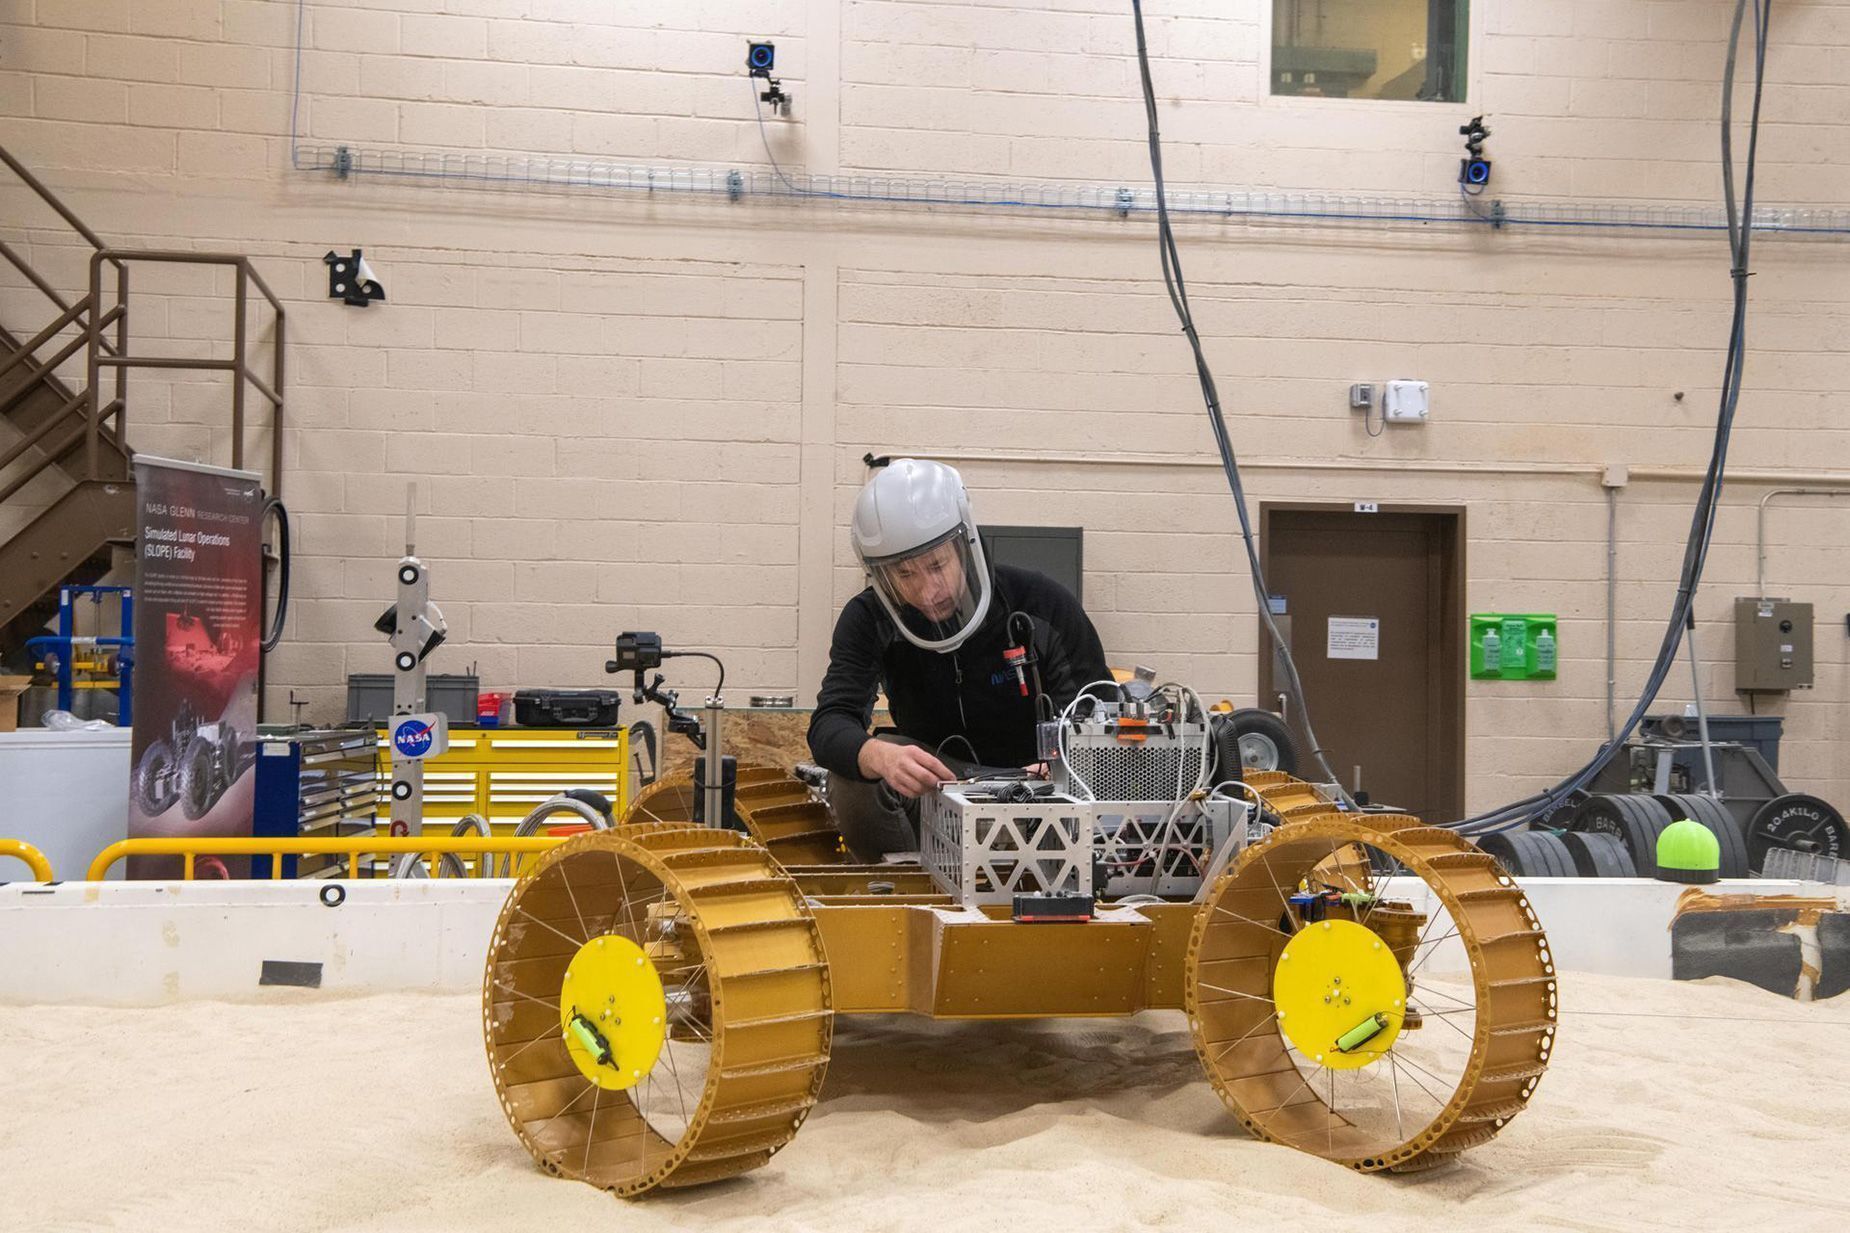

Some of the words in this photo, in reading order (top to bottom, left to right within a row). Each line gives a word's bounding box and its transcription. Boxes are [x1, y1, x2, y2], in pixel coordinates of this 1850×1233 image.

[146, 502, 167, 515] NASA
[170, 505, 196, 518] GLENN
[197, 510, 227, 522] RESEARCH
[229, 514, 249, 525] CENTER
[145, 526, 177, 541] Simulated
[178, 530, 196, 543] Lunar
[197, 531, 230, 546] Operations
[144, 543, 172, 560] (SLOPE)
[174, 546, 196, 563] Facility
[991, 669, 1018, 686] NAS
[397, 732, 430, 745] NASA
